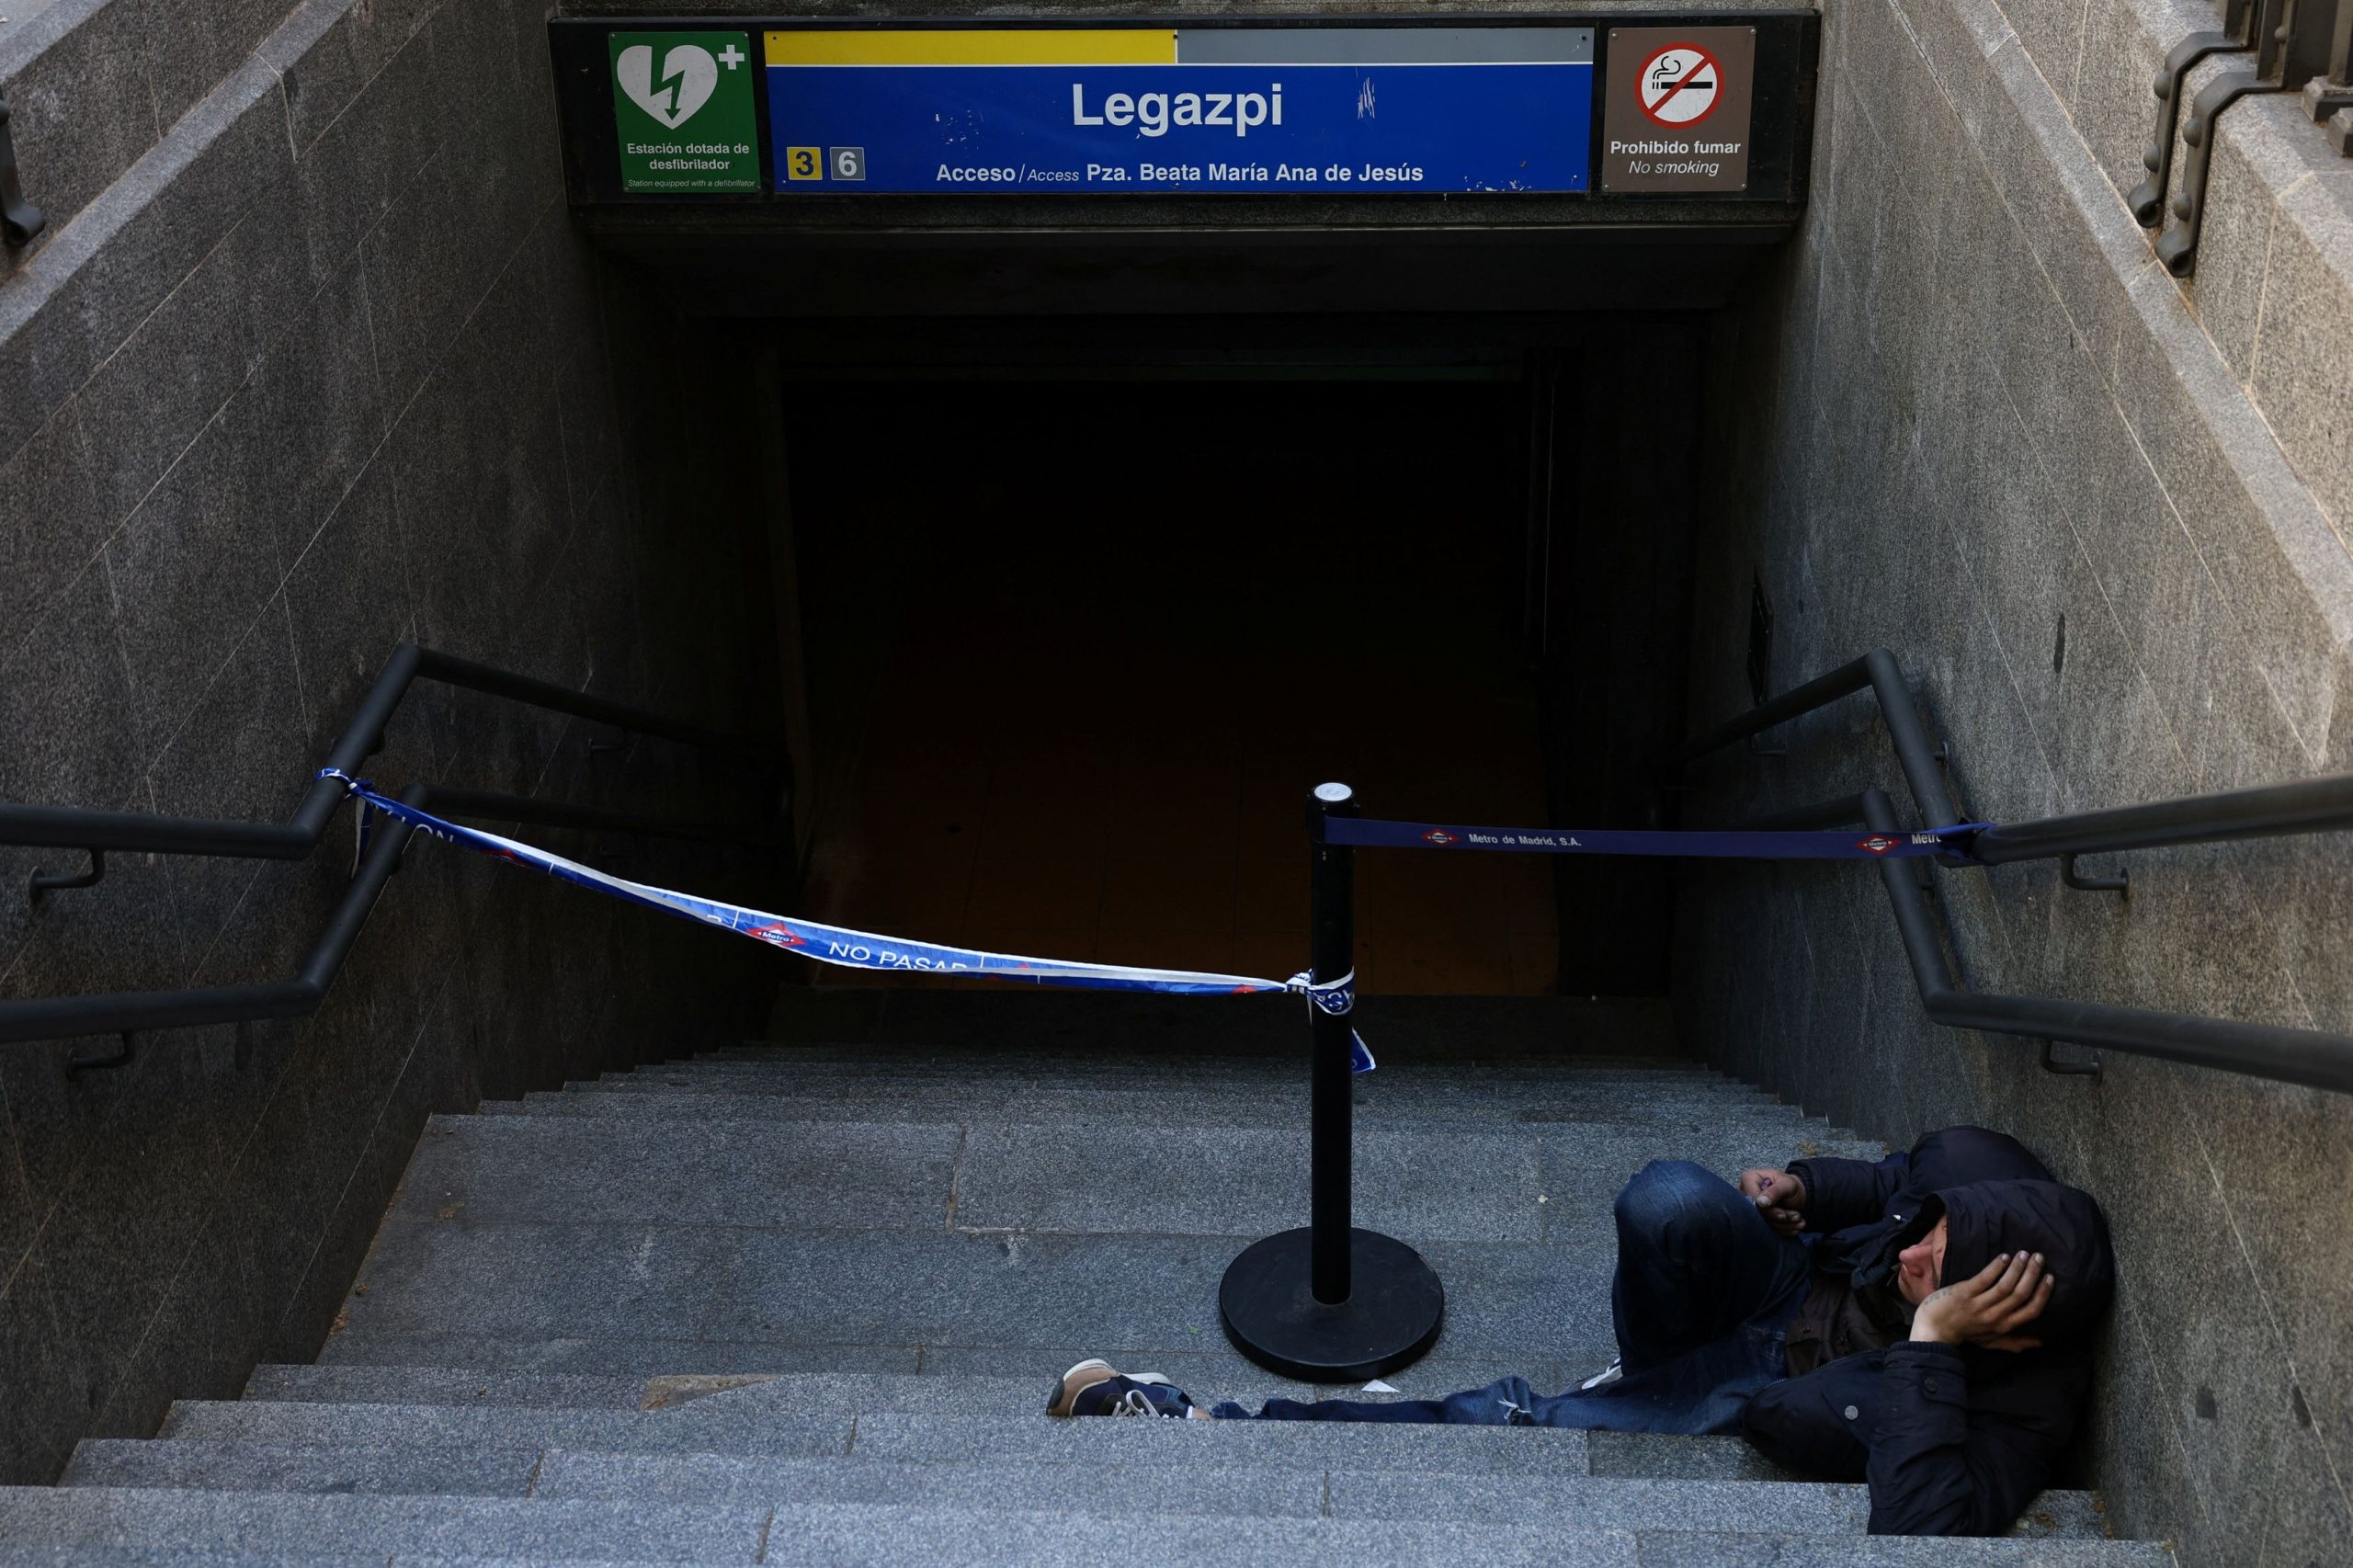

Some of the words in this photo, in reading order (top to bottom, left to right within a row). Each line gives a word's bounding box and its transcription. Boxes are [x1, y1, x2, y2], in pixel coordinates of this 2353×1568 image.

[1073, 83, 1282, 137] Legazpi
[627, 142, 682, 154] Estación
[686, 143, 730, 154] dotada
[733, 143, 750, 154] de
[1610, 141, 1688, 154] Prohibido
[1694, 141, 1741, 154] fumar
[649, 159, 730, 170] desfibrilador
[795, 152, 814, 176] 3
[837, 151, 858, 176] 6
[1629, 161, 1651, 174] No
[1654, 160, 1720, 176] smoking
[1086, 164, 1131, 182] Pza.
[1140, 164, 1200, 182] Beata
[1209, 163, 1268, 182] María
[1275, 164, 1317, 182] Ana
[1324, 164, 1352, 182] de
[1358, 163, 1424, 182] Jesús
[628, 179, 654, 187] Station
[654, 179, 689, 189] equipped
[690, 179, 706, 187] with
[714, 179, 756, 187] defibrillator
[1469, 833, 1498, 844] Metro
[1502, 835, 1516, 845] de
[1518, 835, 1557, 846] Madrid,
[1560, 837, 1582, 846] S.A.
[762, 931, 790, 942] Metro
[829, 941, 870, 960] NO
